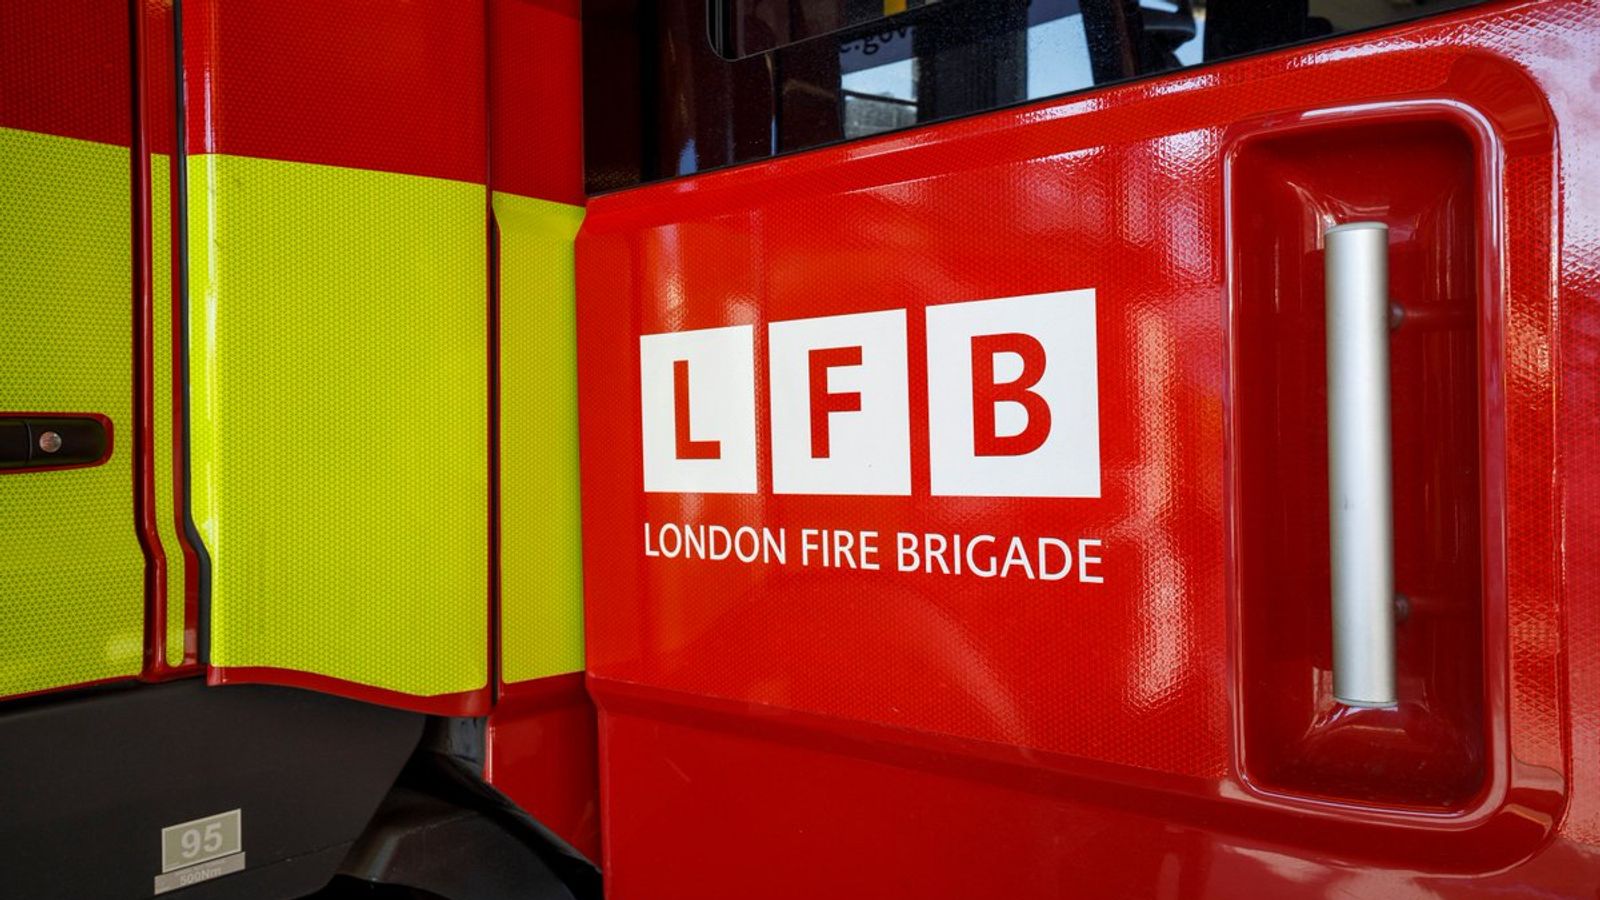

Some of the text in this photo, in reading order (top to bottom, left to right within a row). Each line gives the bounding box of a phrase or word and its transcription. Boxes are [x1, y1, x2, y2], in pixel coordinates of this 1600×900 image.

[644, 522, 1104, 584] LONDON FIRE BRIGADE
[181, 822, 222, 858] 95
